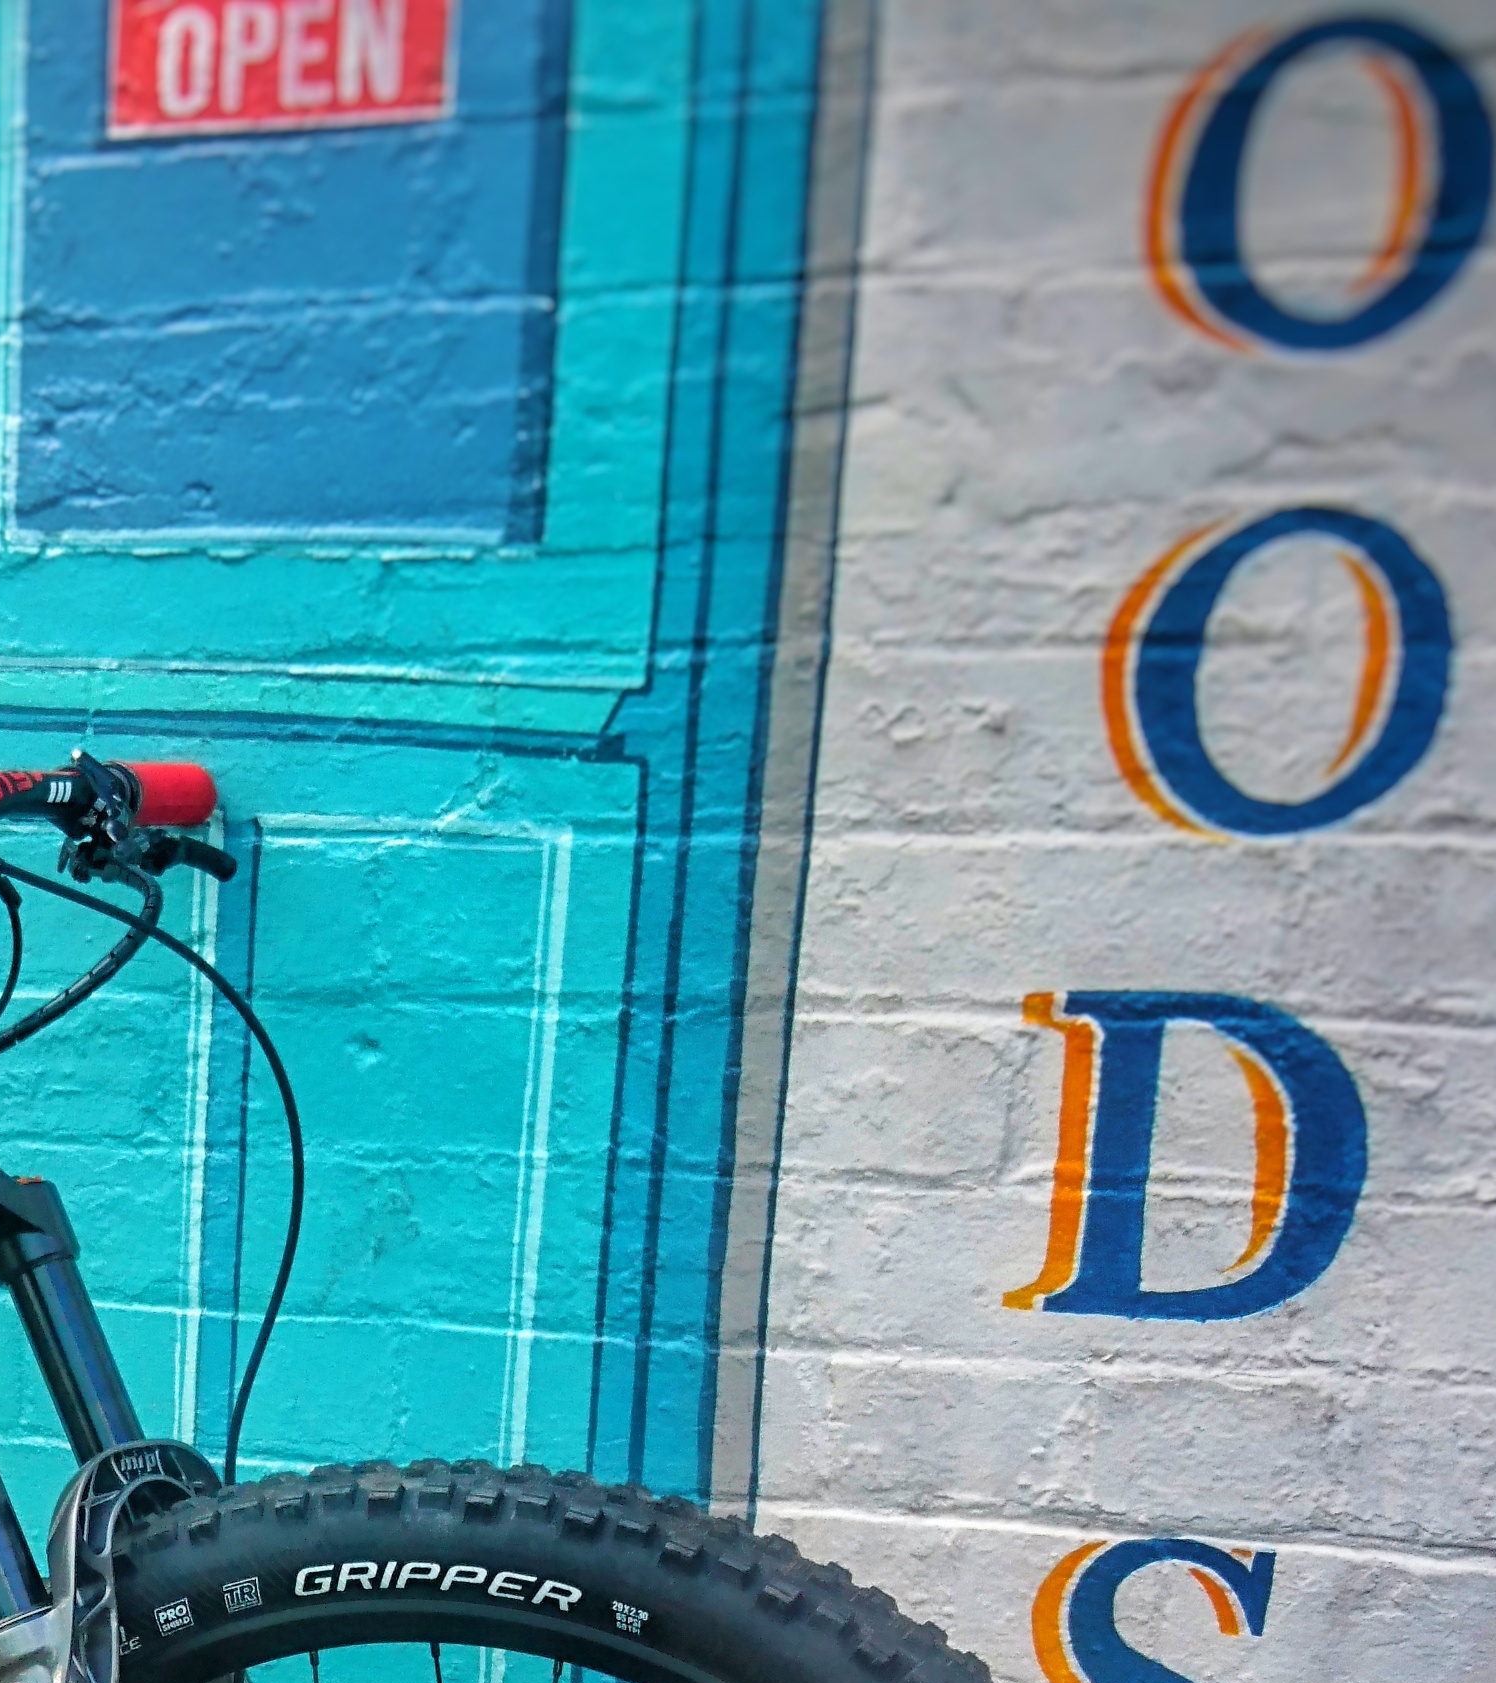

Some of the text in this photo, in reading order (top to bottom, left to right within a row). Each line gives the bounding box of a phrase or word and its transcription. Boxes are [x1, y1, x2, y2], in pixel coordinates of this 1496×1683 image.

[157, 0, 408, 119] OPEN
[294, 1561, 583, 1612] GRIPPER
[158, 1603, 188, 1624] PRO
